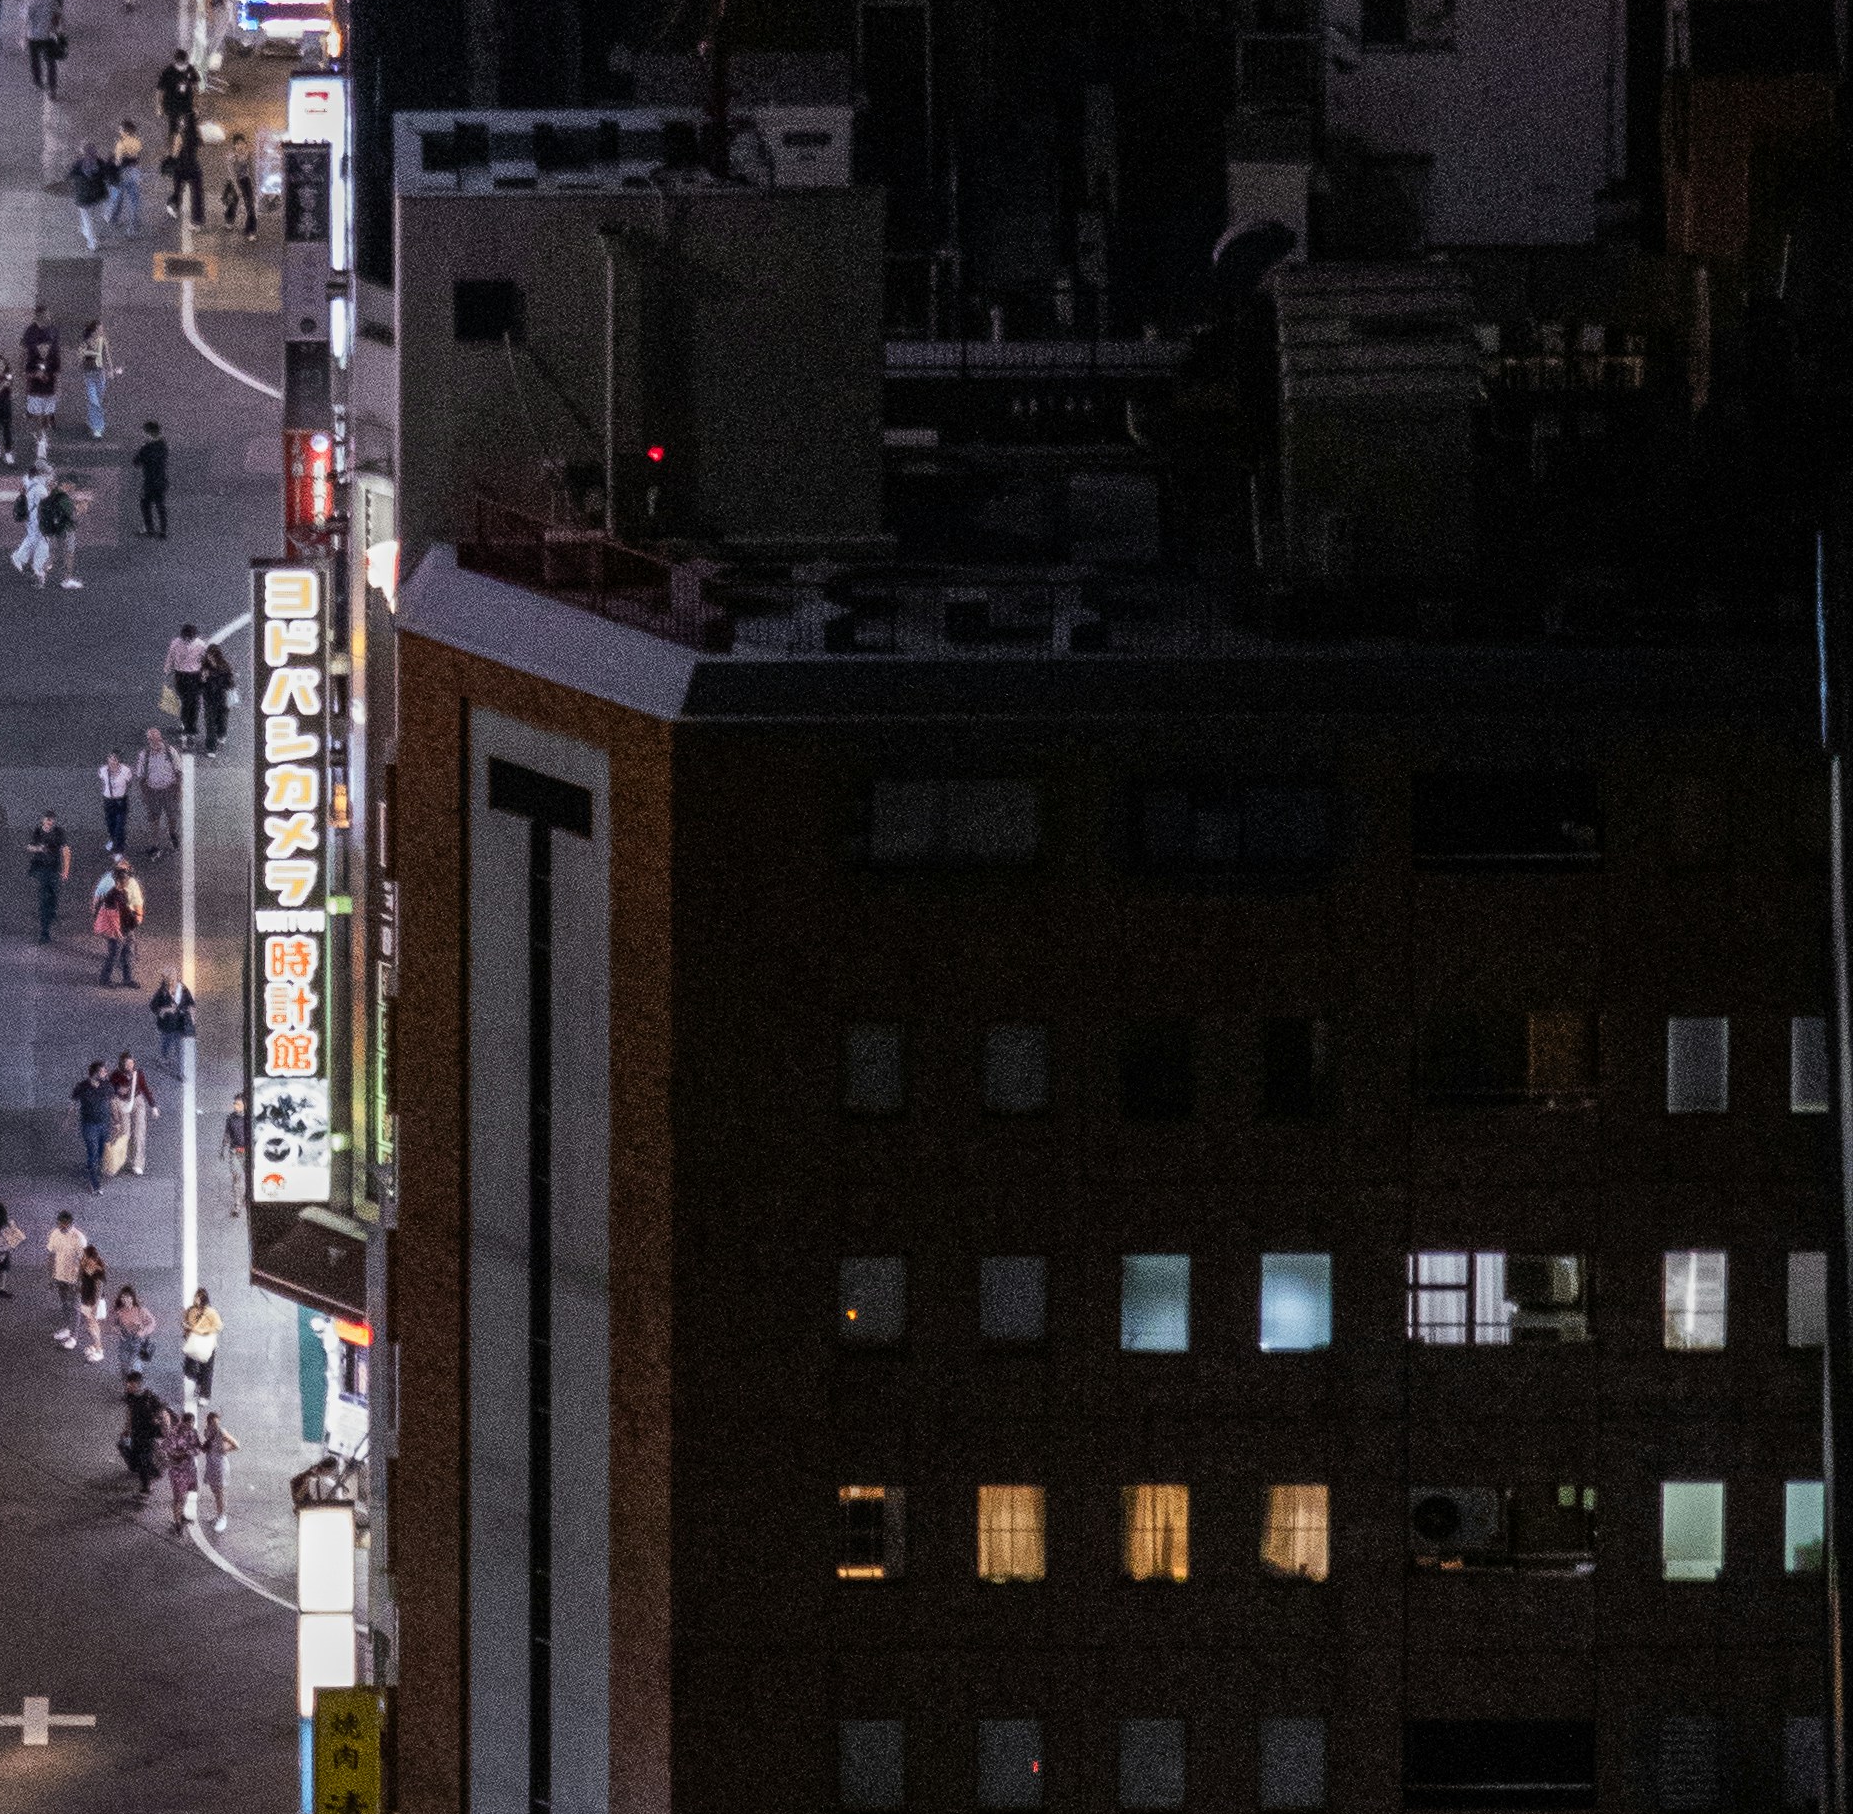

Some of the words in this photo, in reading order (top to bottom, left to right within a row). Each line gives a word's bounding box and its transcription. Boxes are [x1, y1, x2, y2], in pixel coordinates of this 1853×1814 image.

[261, 569, 321, 909] ヨドバシカメラ
[264, 935, 320, 1077] 時計館
